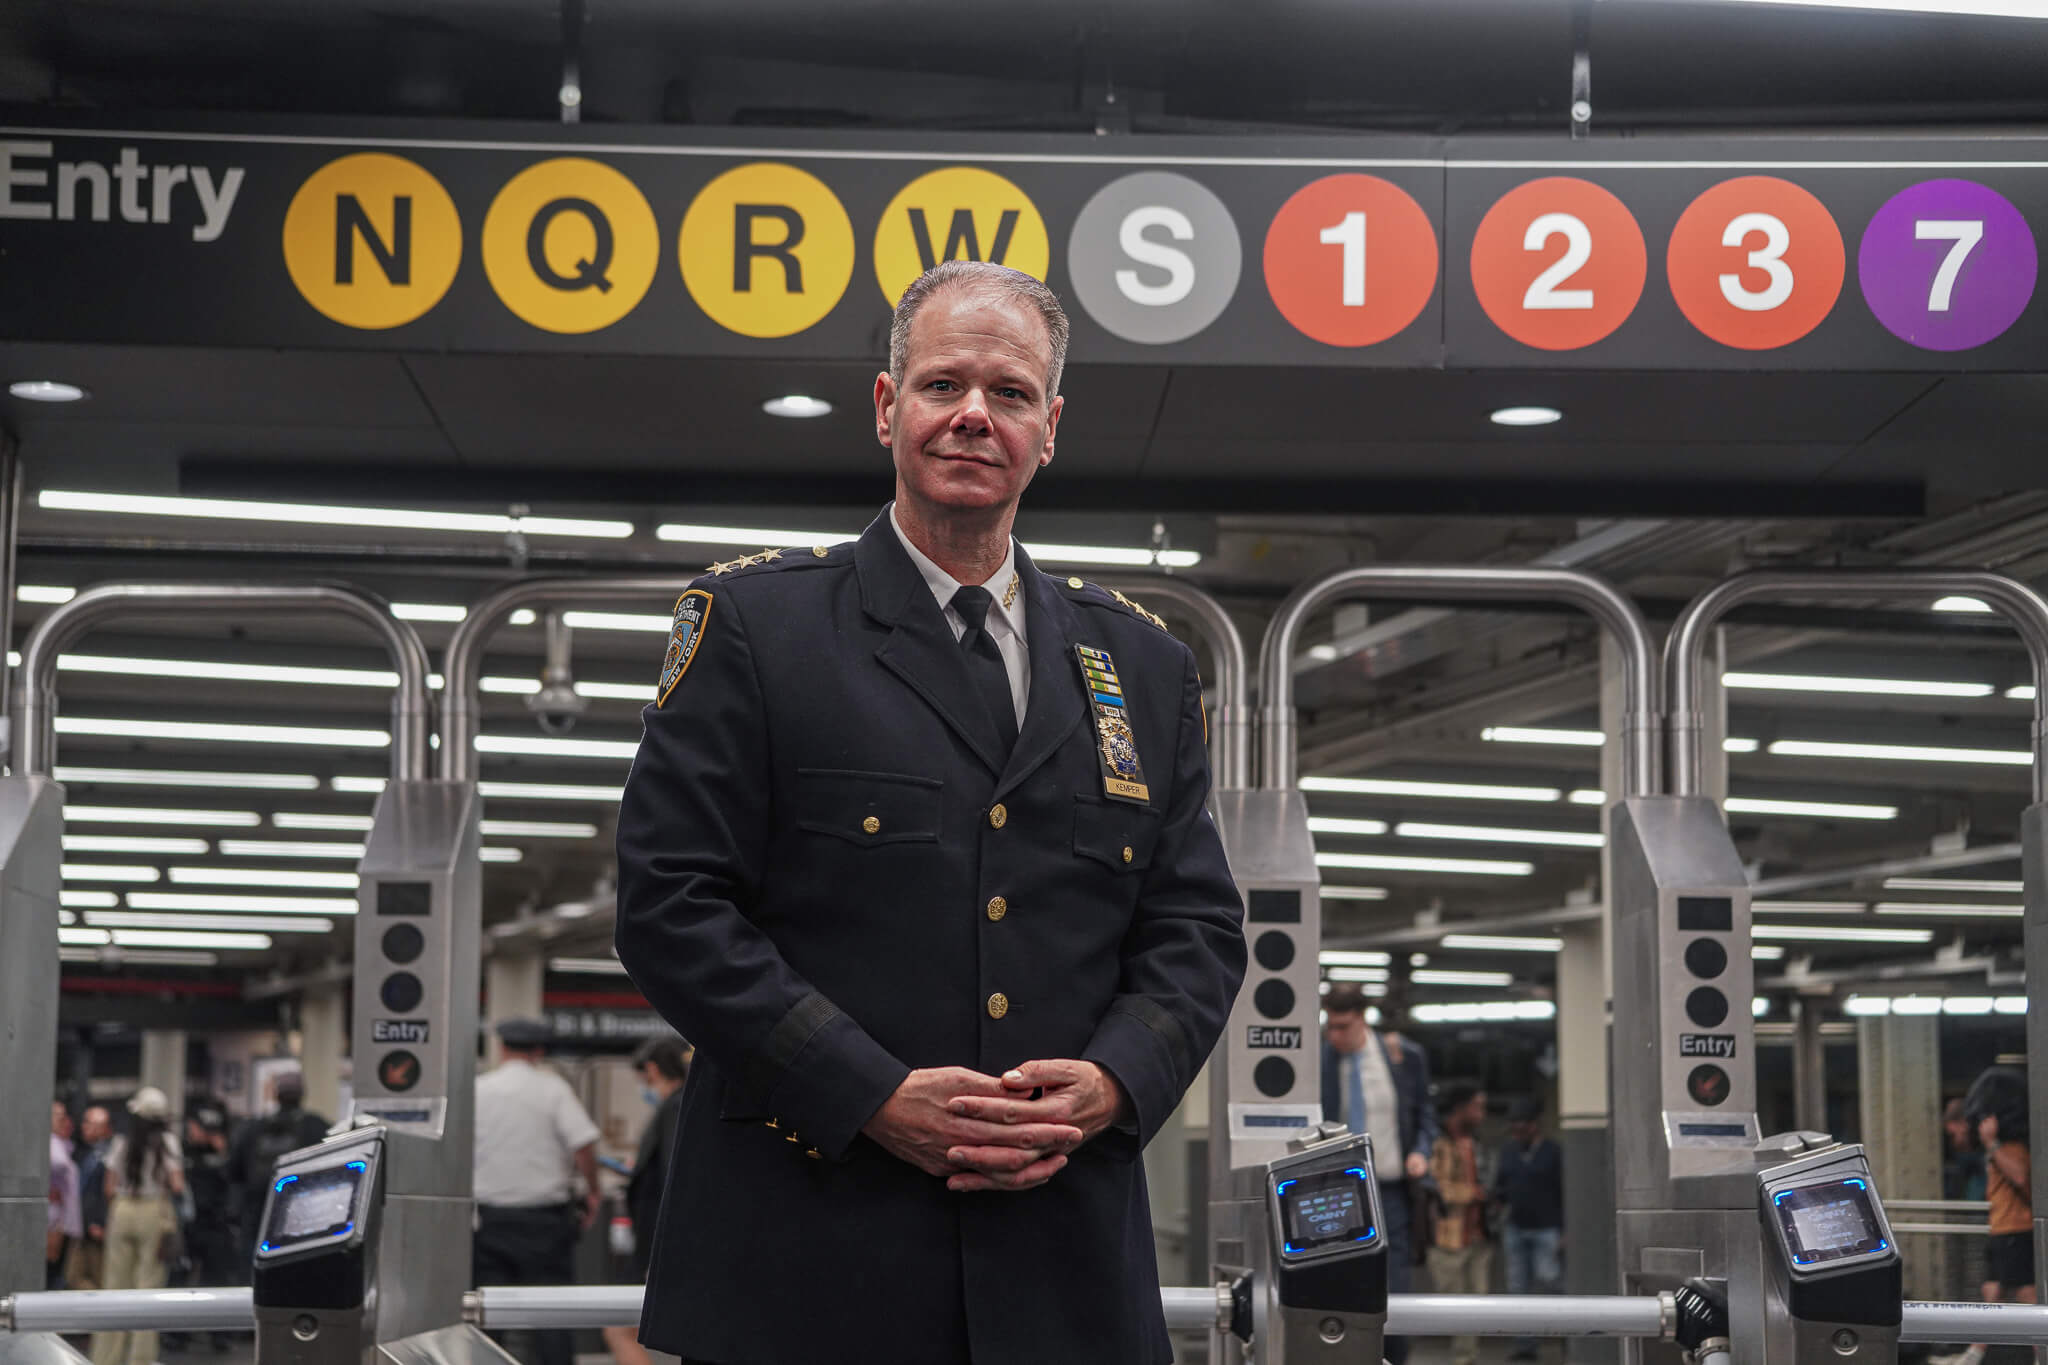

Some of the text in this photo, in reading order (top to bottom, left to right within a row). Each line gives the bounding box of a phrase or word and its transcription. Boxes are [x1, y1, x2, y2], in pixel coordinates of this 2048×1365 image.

[0, 139, 1984, 312] Entry N Q R W S 1 2 3 7
[680, 631, 700, 664] YORK
[1115, 782, 1140, 795] KEMPER
[375, 1021, 428, 1044] Entry
[1248, 1027, 1300, 1048] Entry
[1681, 1035, 1734, 1057] Entry
[1308, 1209, 1347, 1223] OMNY
